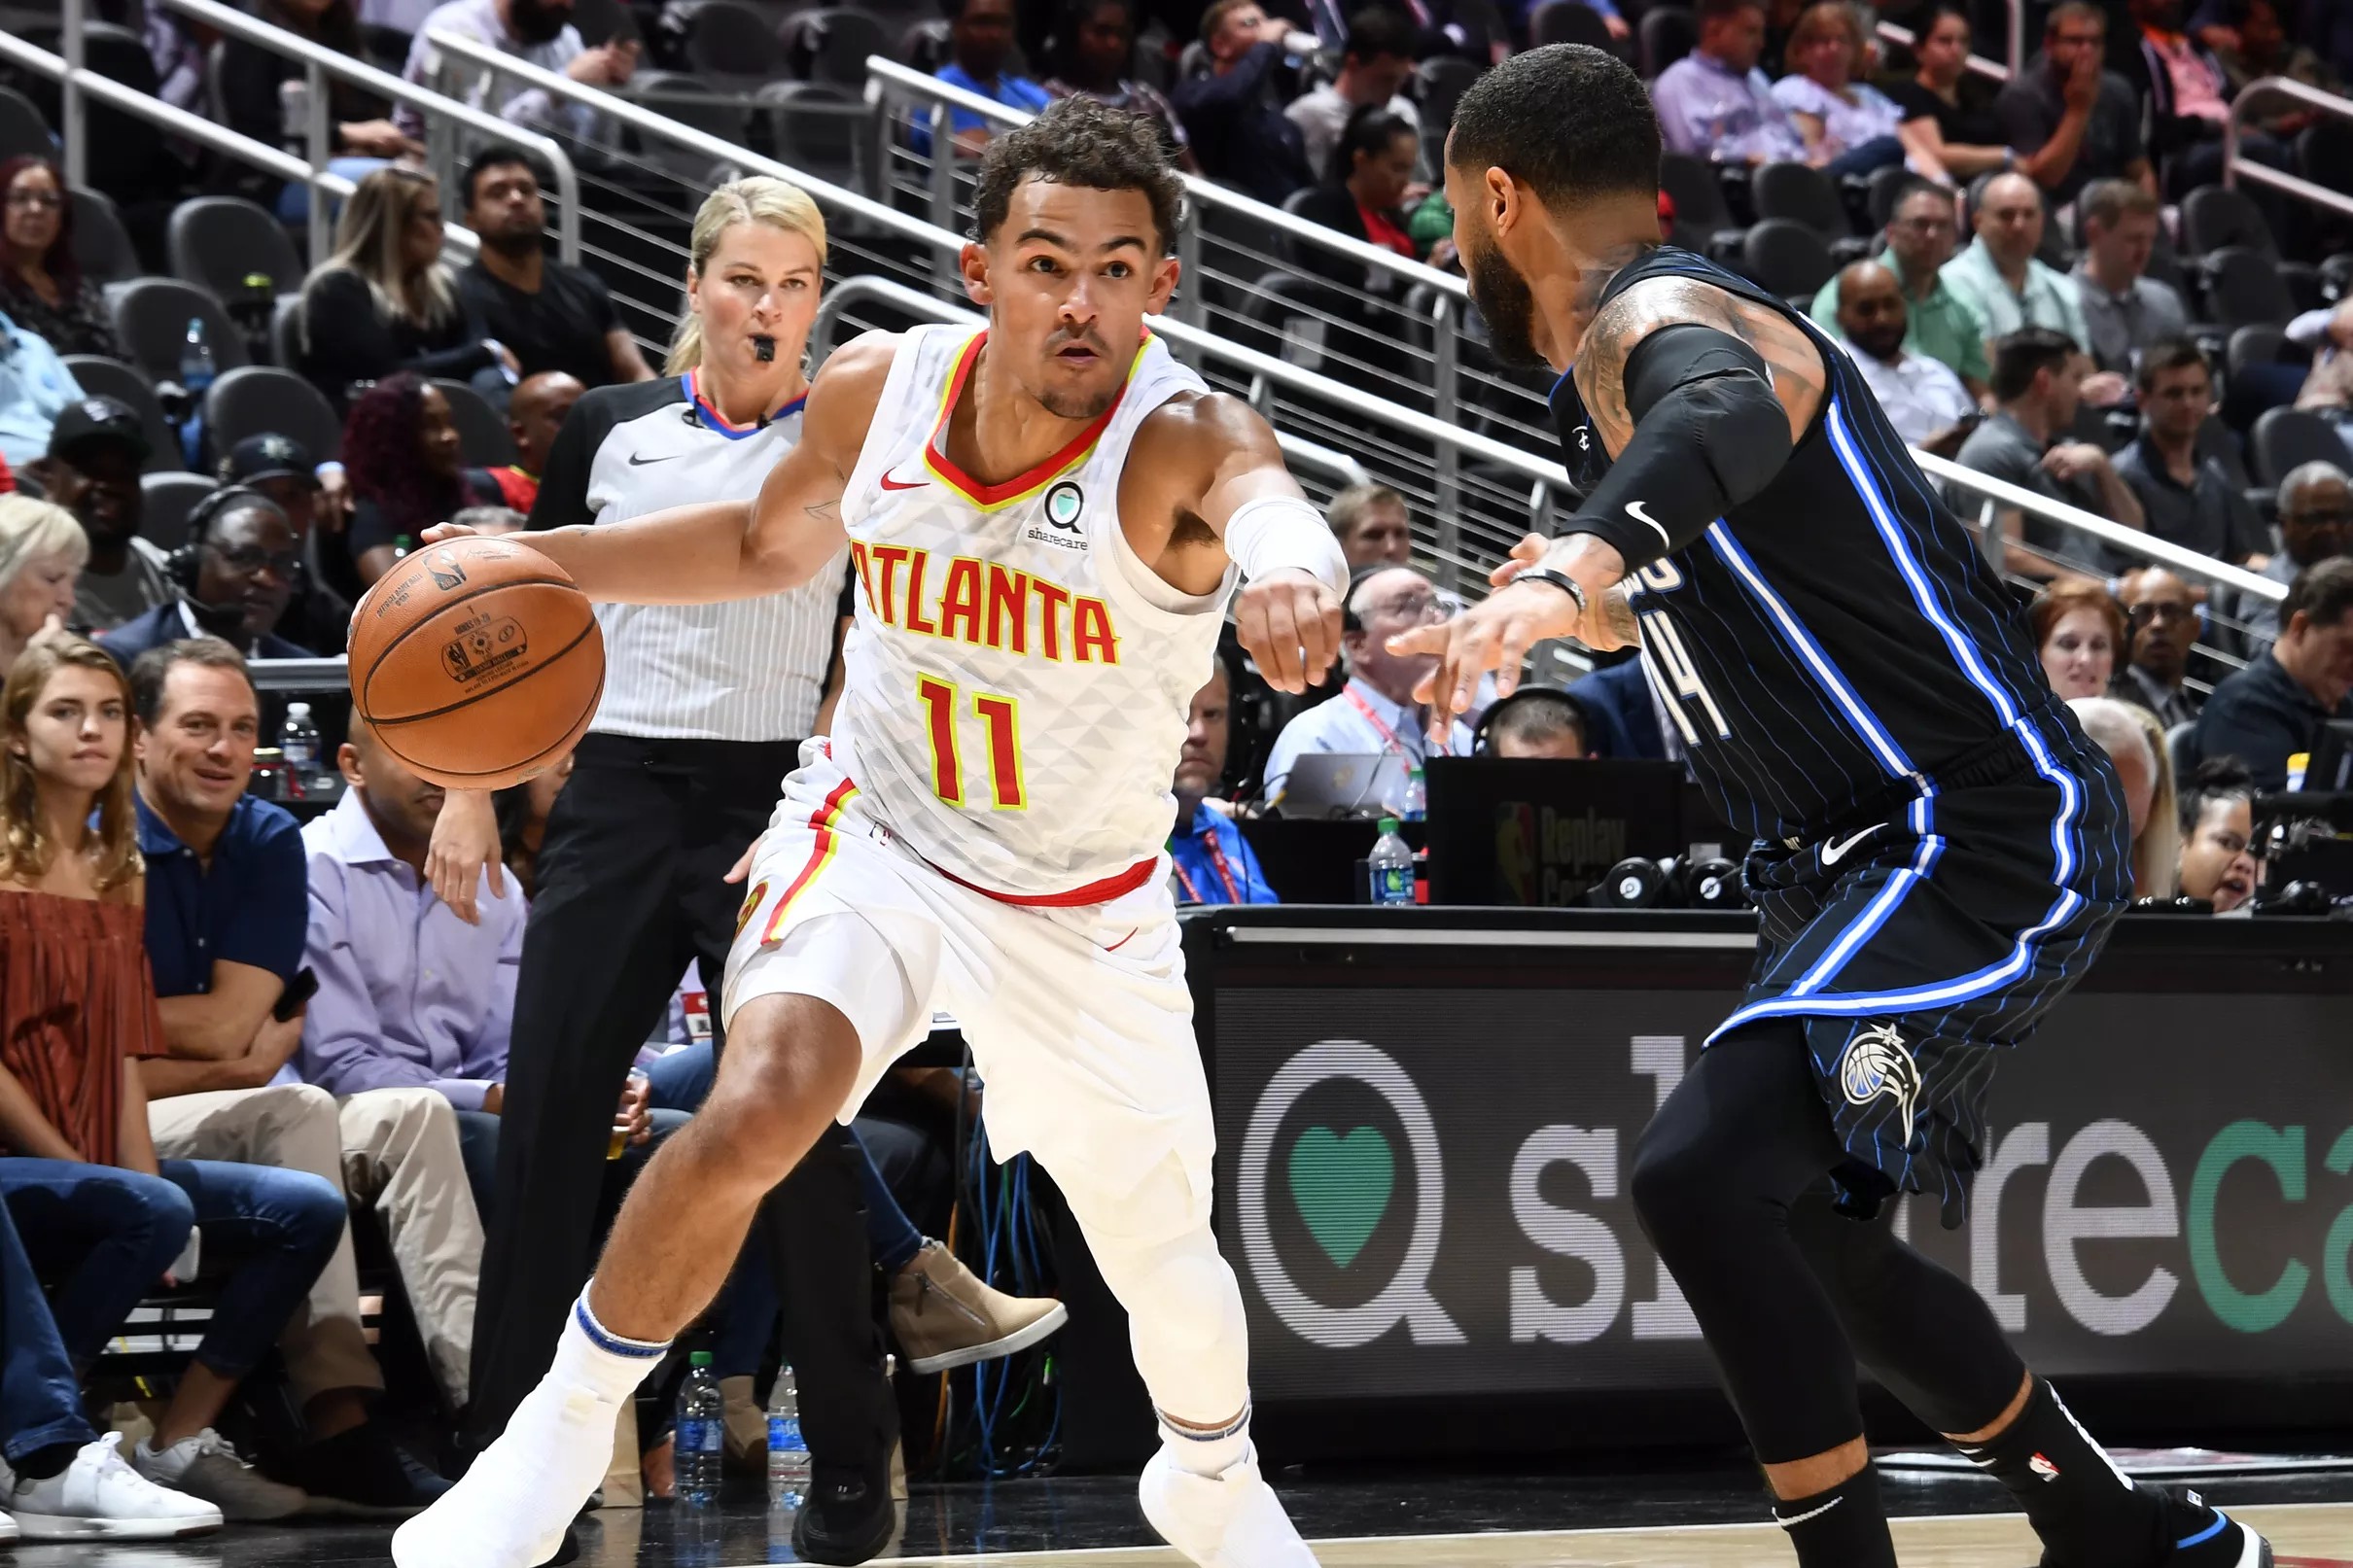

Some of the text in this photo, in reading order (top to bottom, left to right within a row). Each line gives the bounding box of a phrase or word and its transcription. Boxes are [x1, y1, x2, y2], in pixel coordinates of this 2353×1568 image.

[1027, 527, 1088, 551] sharecare
[849, 538, 1122, 666] ATLANTA
[916, 671, 1027, 810] 11
[1540, 804, 1627, 877] Replay
